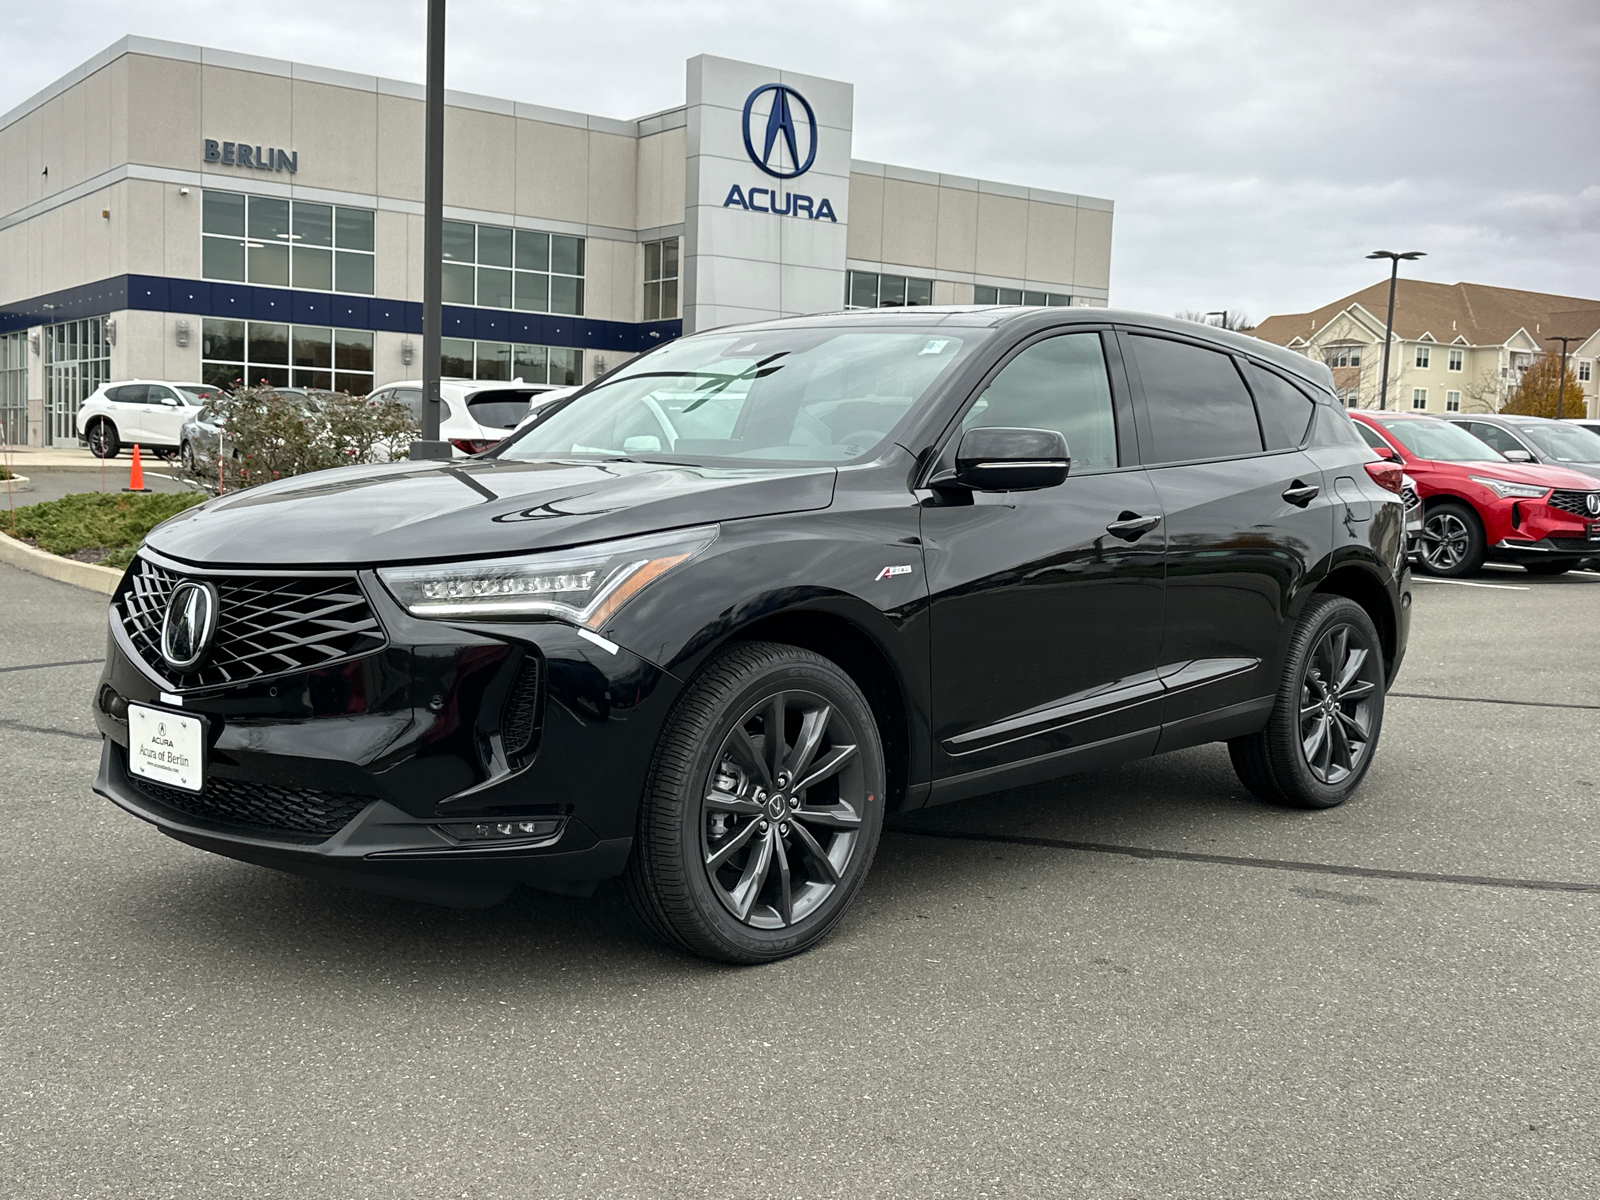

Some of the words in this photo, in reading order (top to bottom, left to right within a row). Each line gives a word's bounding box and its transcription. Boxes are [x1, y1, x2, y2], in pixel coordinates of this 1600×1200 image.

[203, 139, 297, 173] BERLIN
[723, 184, 838, 222] ACURA
[139, 744, 157, 760] Acura
[158, 751, 165, 762] of
[167, 751, 189, 767] Berlin
[152, 736, 174, 747] ACURA
